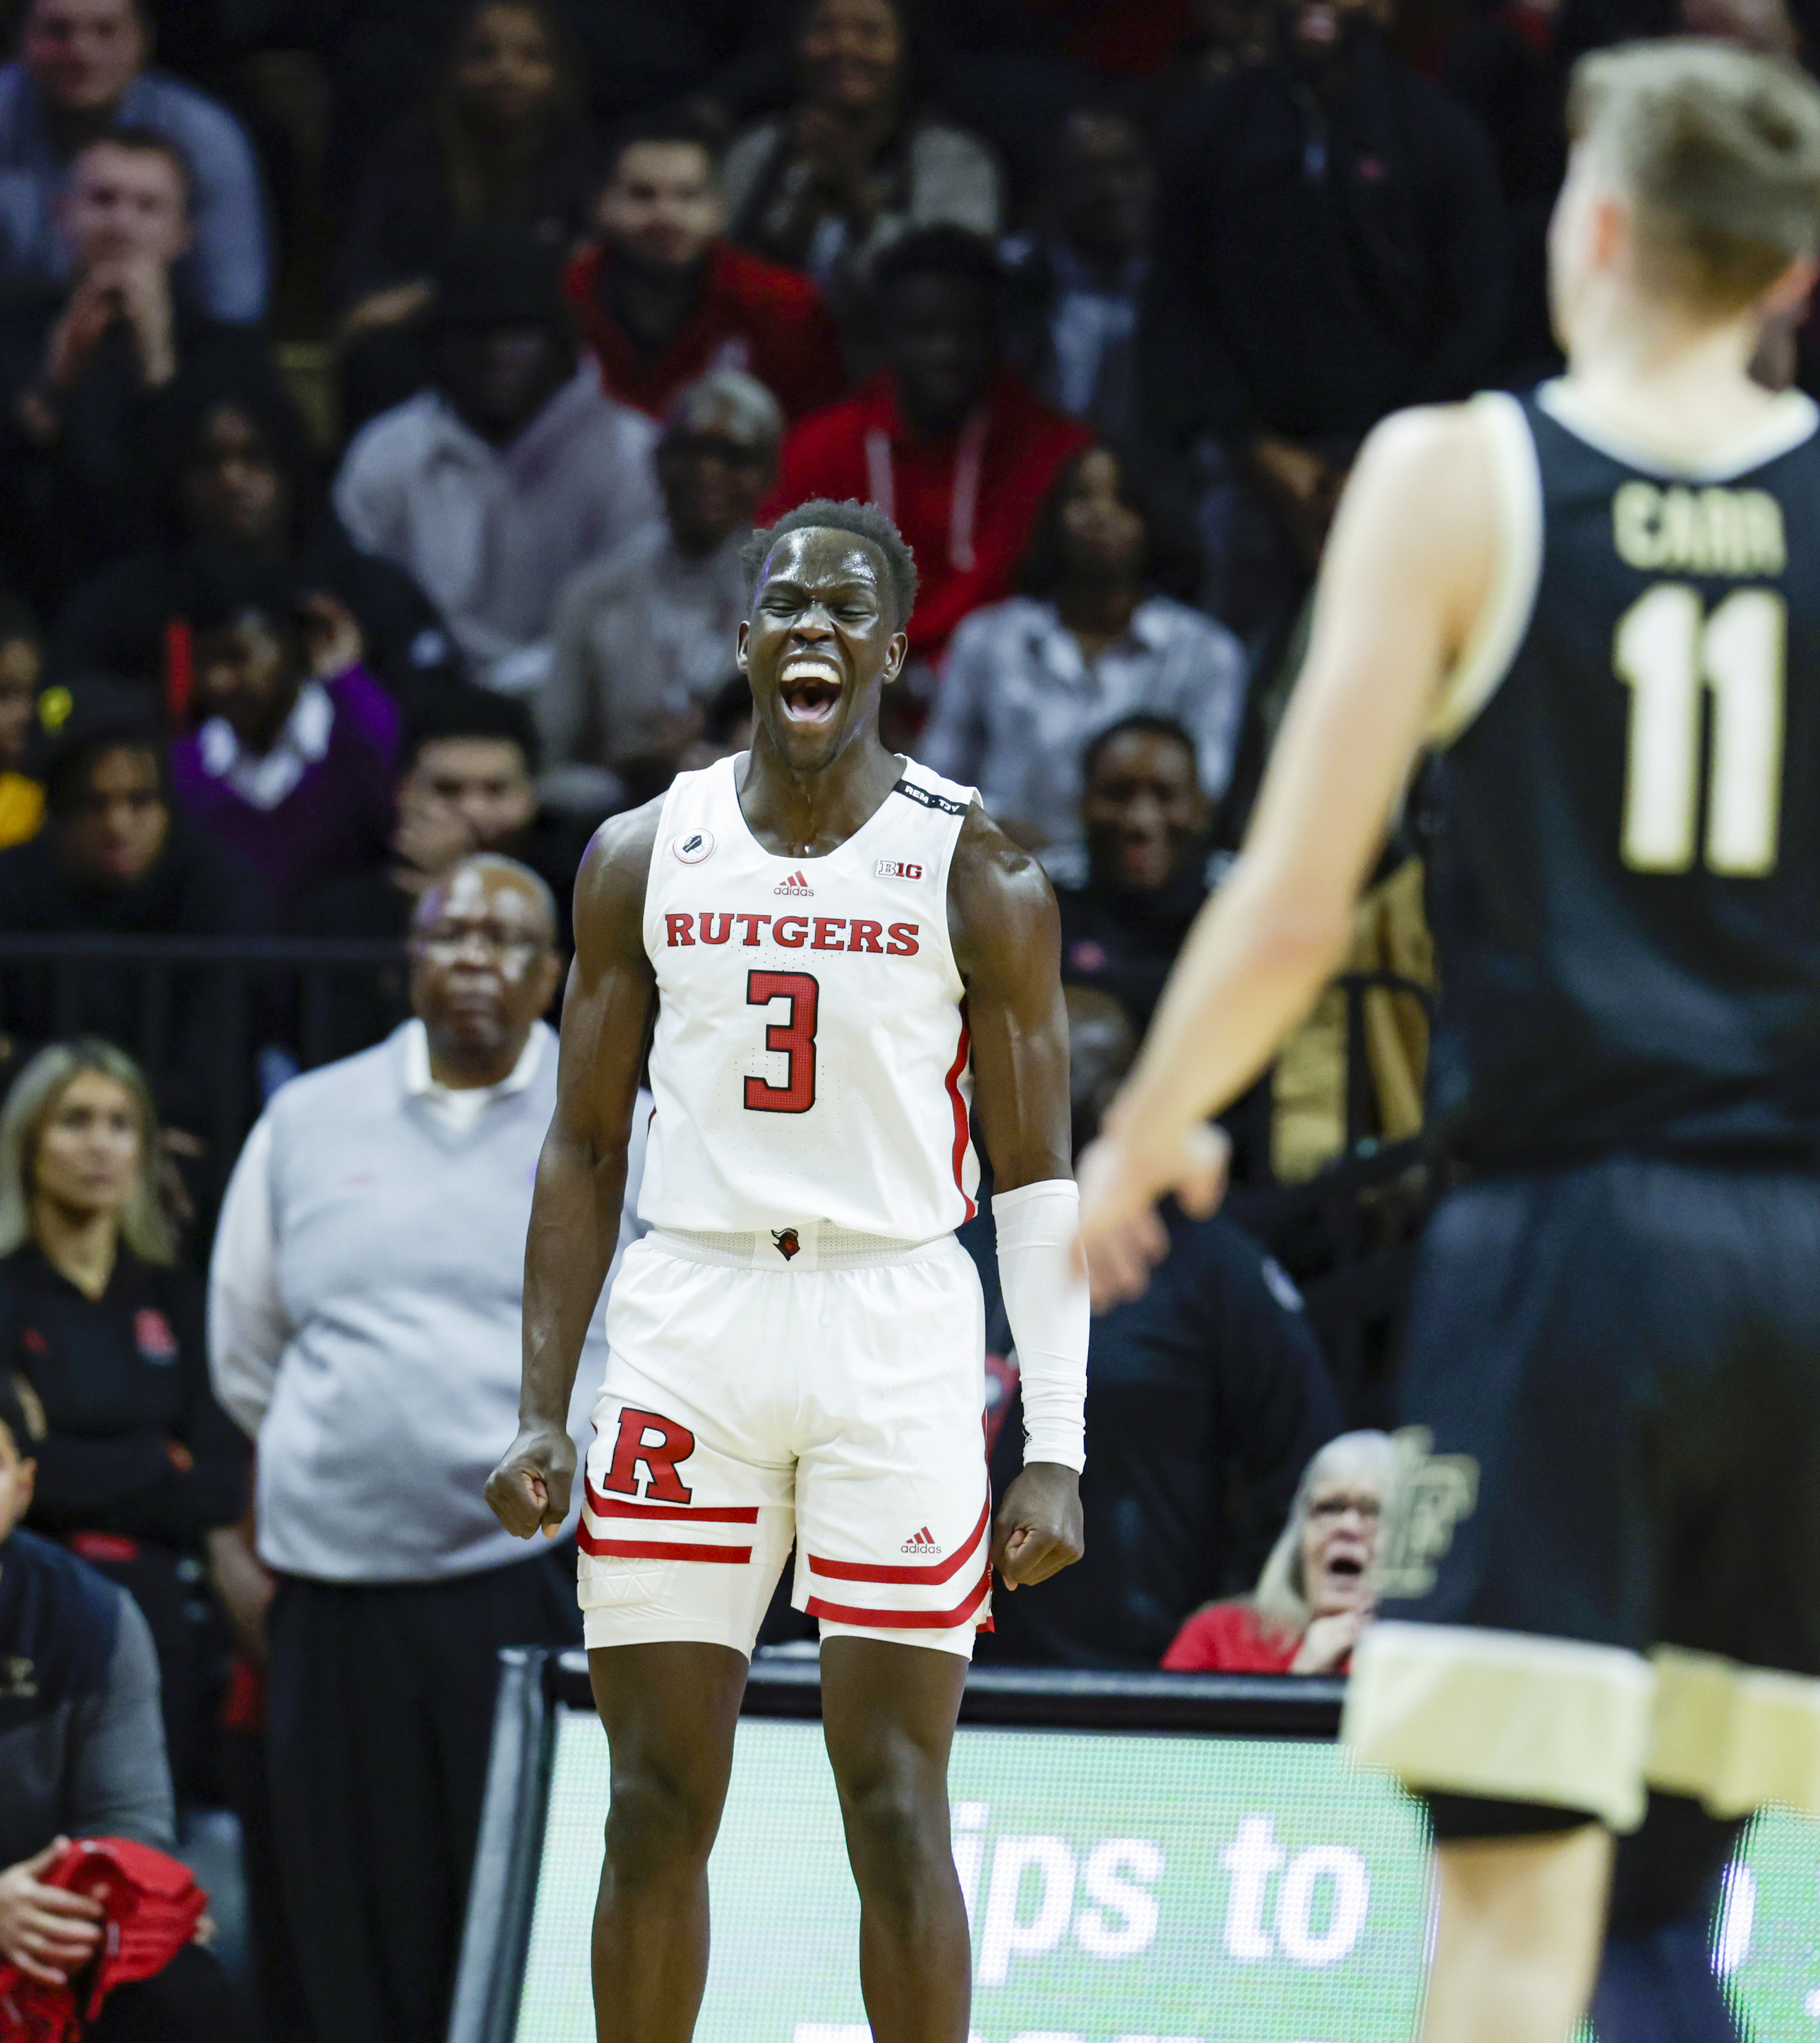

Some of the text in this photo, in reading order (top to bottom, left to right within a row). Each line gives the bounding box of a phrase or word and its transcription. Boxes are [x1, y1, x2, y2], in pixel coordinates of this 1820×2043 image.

[1613, 583, 1787, 877] 11
[905, 785, 929, 804] REM
[774, 886, 814, 897] adidas
[665, 912, 919, 956] RUTGERS
[744, 970, 819, 1113] 3
[603, 1407, 694, 1504] R
[901, 1543, 942, 1554] adidas
[1218, 1812, 1371, 1965] to
